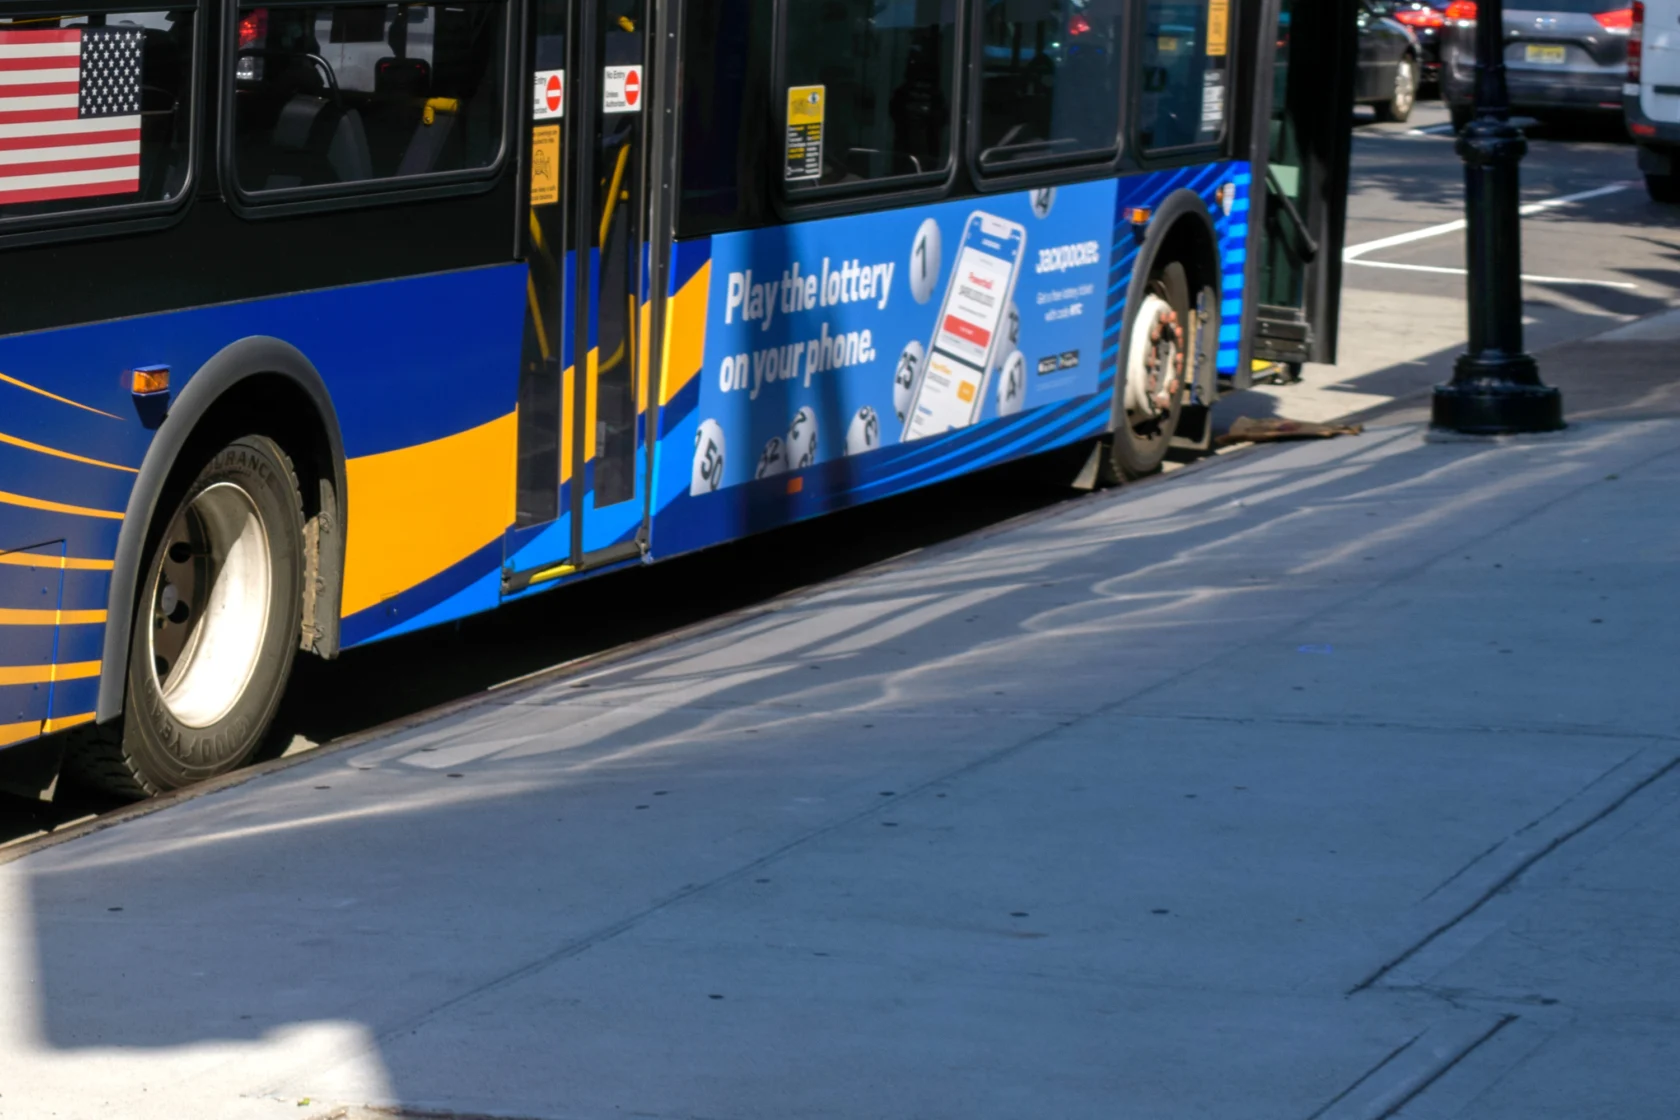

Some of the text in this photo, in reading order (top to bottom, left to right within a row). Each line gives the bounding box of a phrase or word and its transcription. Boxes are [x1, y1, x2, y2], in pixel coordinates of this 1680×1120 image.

[916, 235, 927, 281] 1
[725, 257, 895, 331] Play the lottery
[719, 322, 876, 400] on your phone.
[701, 438, 723, 491] 50
